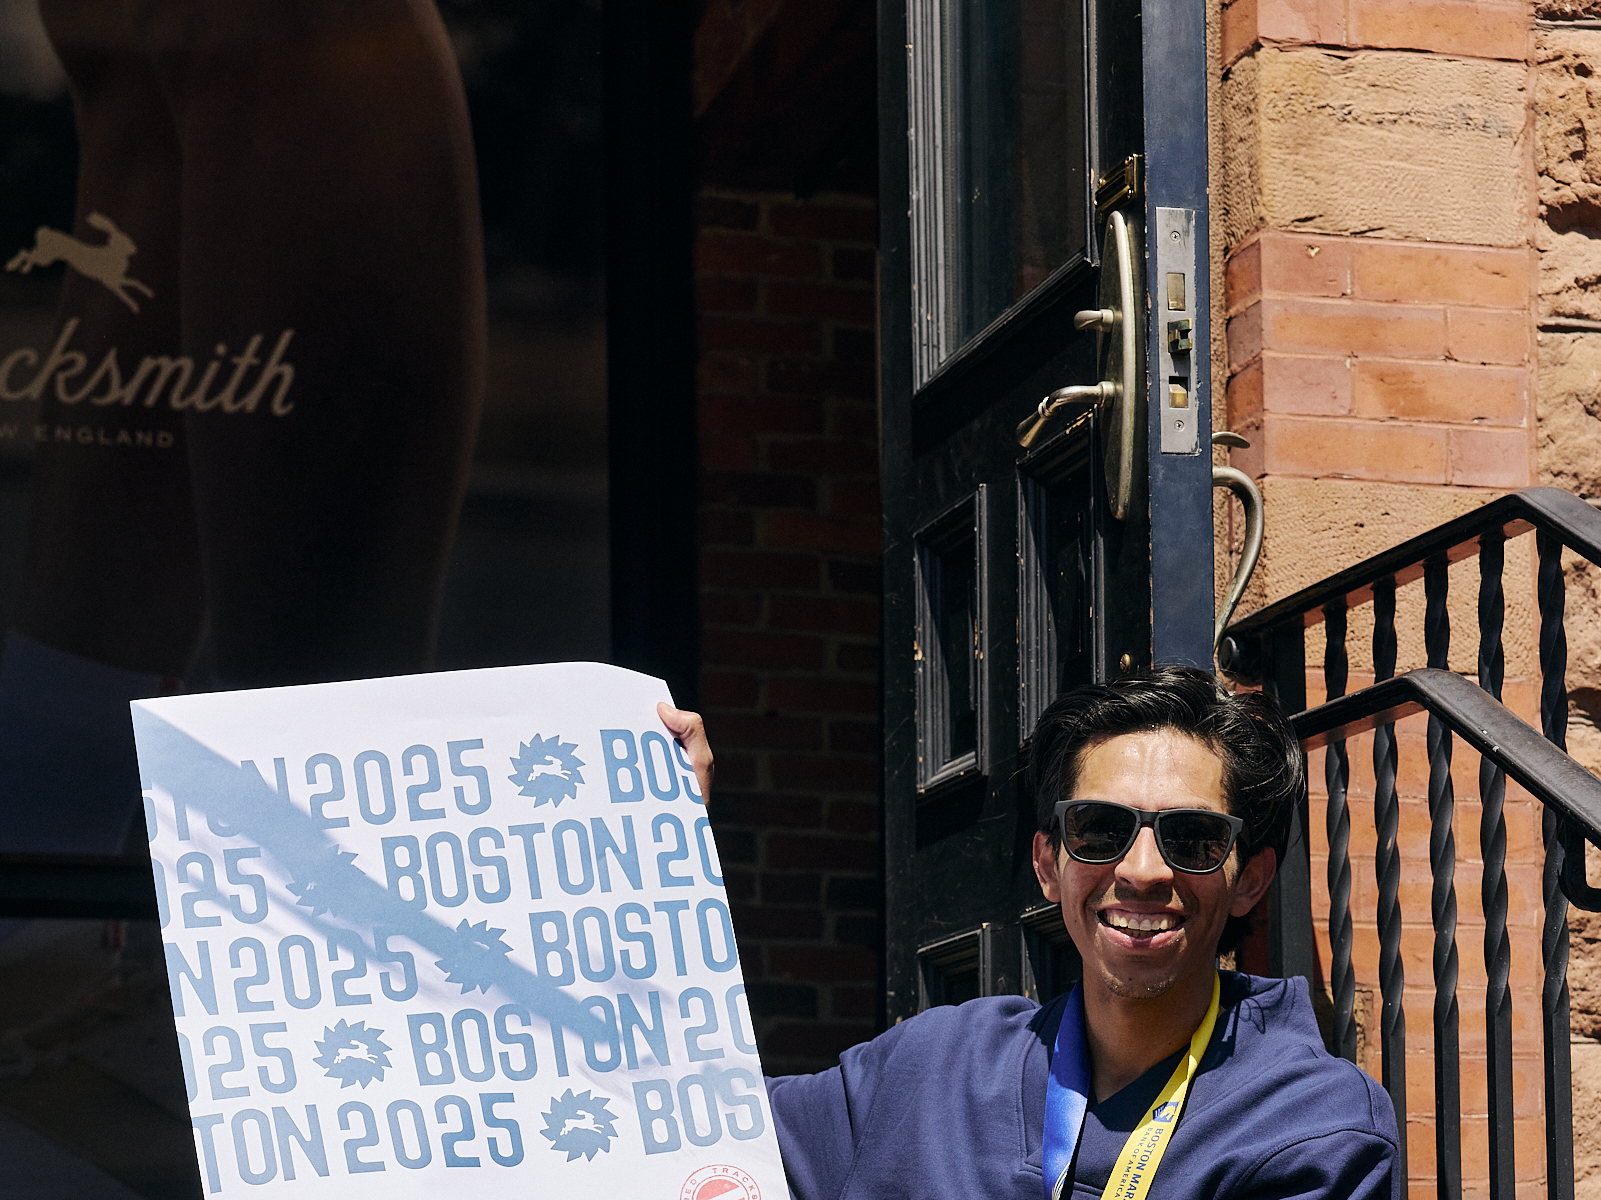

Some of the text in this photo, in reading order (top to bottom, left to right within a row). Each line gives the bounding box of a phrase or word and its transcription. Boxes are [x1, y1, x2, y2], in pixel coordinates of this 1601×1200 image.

[0, 317, 295, 416] cksmith
[33, 424, 175, 448] ENGLAND
[305, 738, 492, 829] 2025
[381, 814, 643, 912] BOSTON
[163, 898, 738, 1017] N 2025 BOSTO
[406, 991, 671, 1086] BOSTON
[191, 1066, 765, 1194] TON 2025 BOS
[1114, 1127, 1154, 1198] BANK OF AMERICA
[1136, 1128, 1164, 1171] BOSTON
